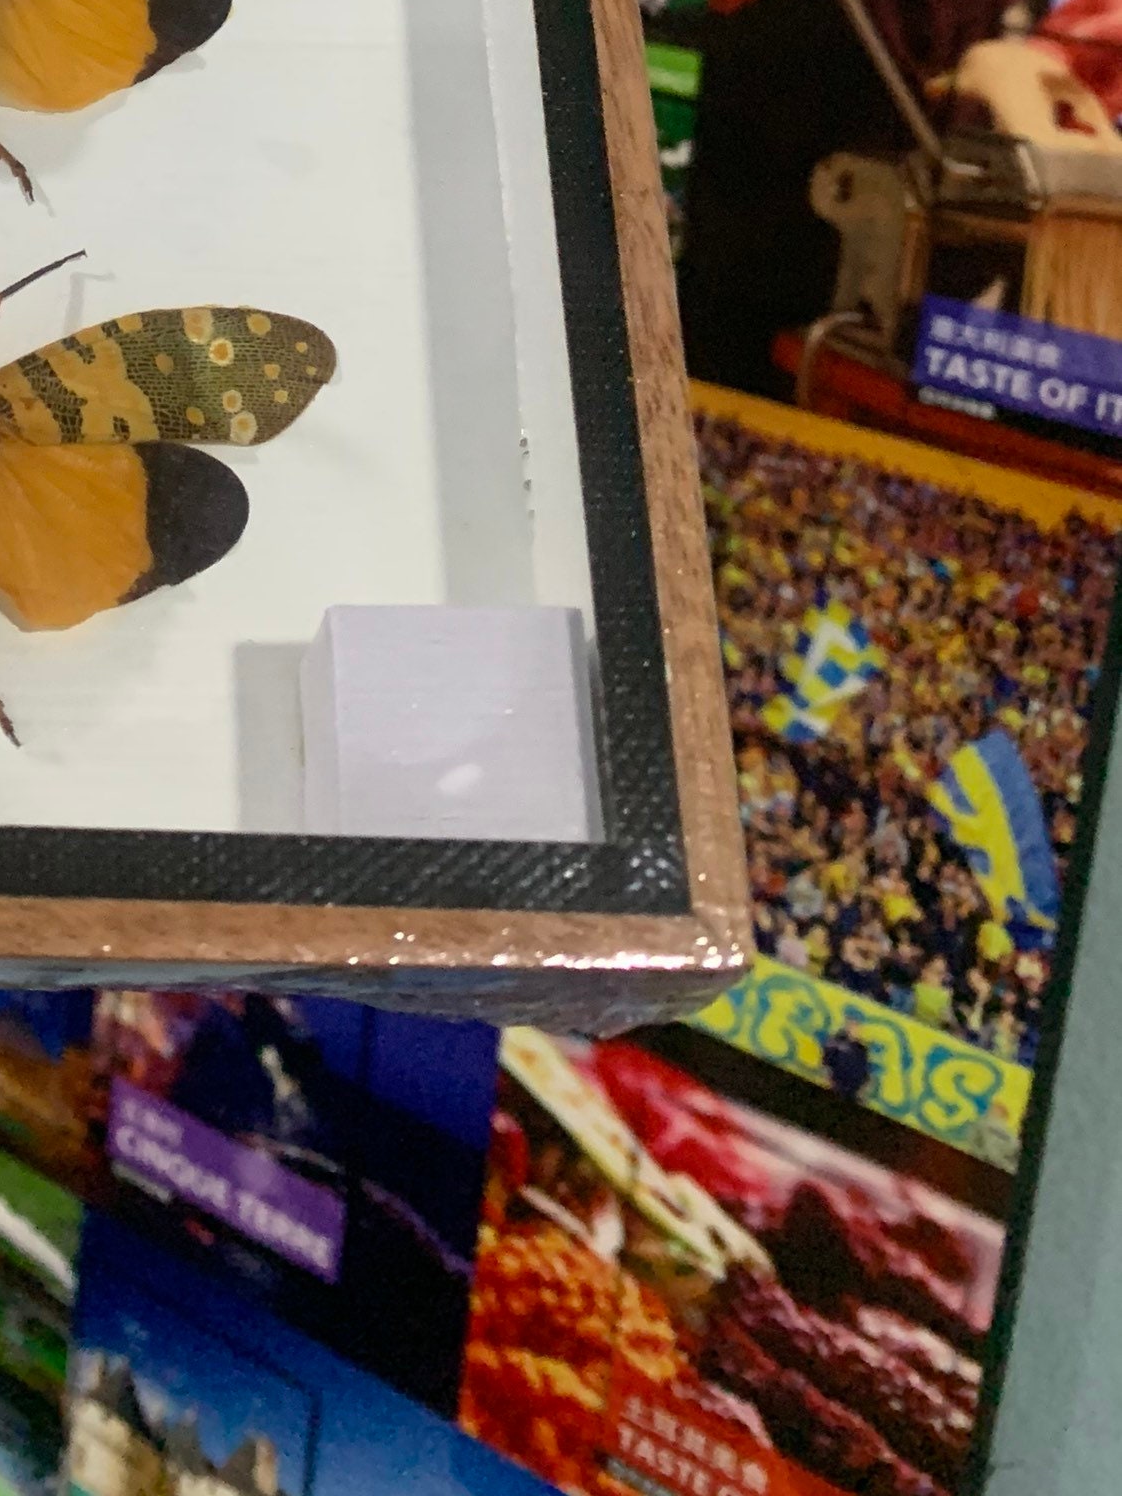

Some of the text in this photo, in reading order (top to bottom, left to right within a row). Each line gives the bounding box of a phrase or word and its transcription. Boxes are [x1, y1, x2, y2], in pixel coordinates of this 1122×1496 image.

[924, 346, 1033, 401] TASTE
[1038, 377, 1089, 411] OF
[617, 1421, 710, 1496] TASTE
